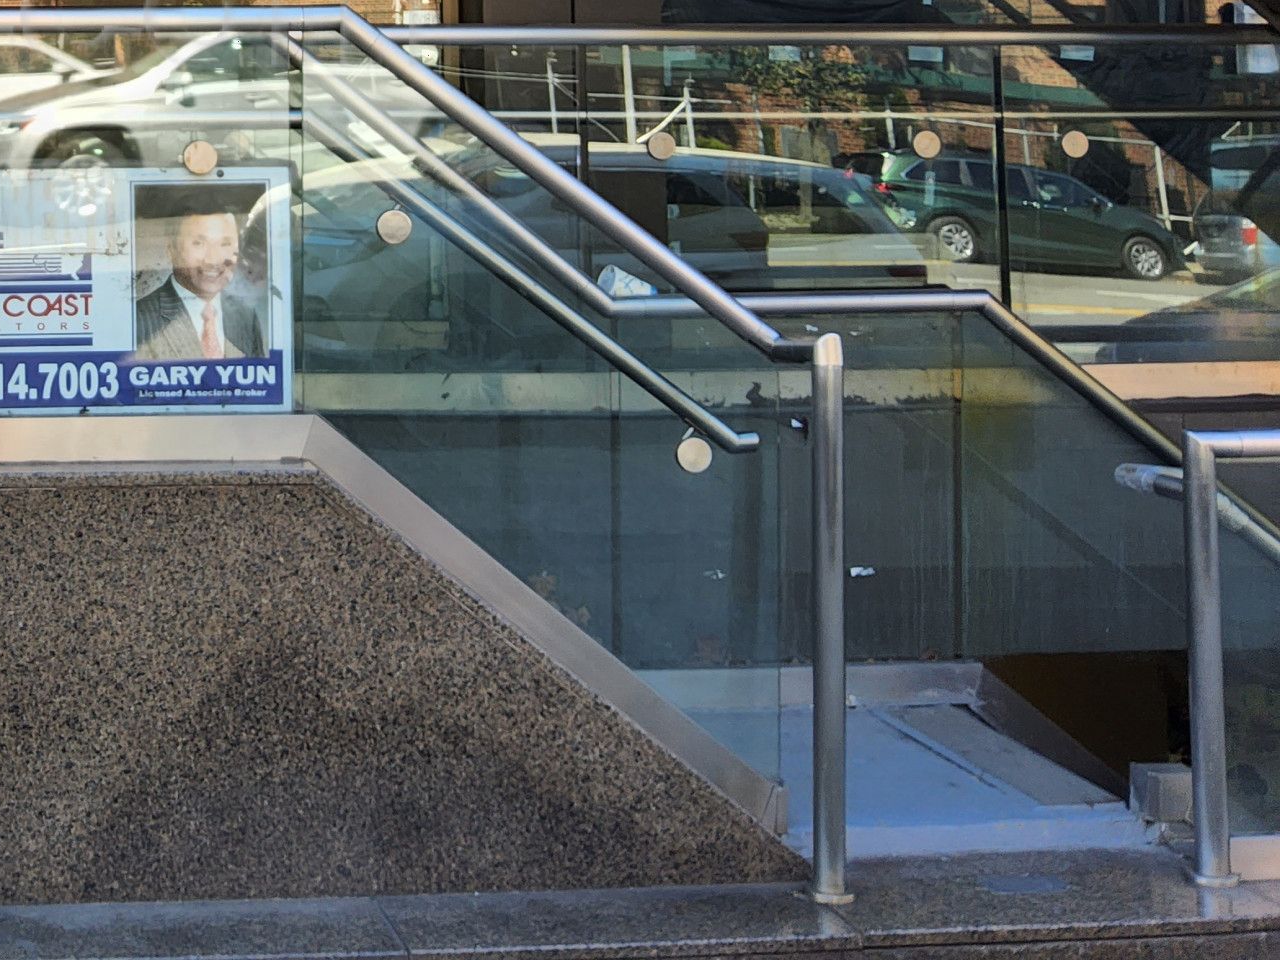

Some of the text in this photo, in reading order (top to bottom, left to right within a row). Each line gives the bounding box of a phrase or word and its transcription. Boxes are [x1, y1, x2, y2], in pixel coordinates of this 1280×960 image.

[2, 294, 93, 318] COAST
[128, 364, 276, 386] GARY YUN
[139, 388, 267, 398] Licensed Associate Broker
